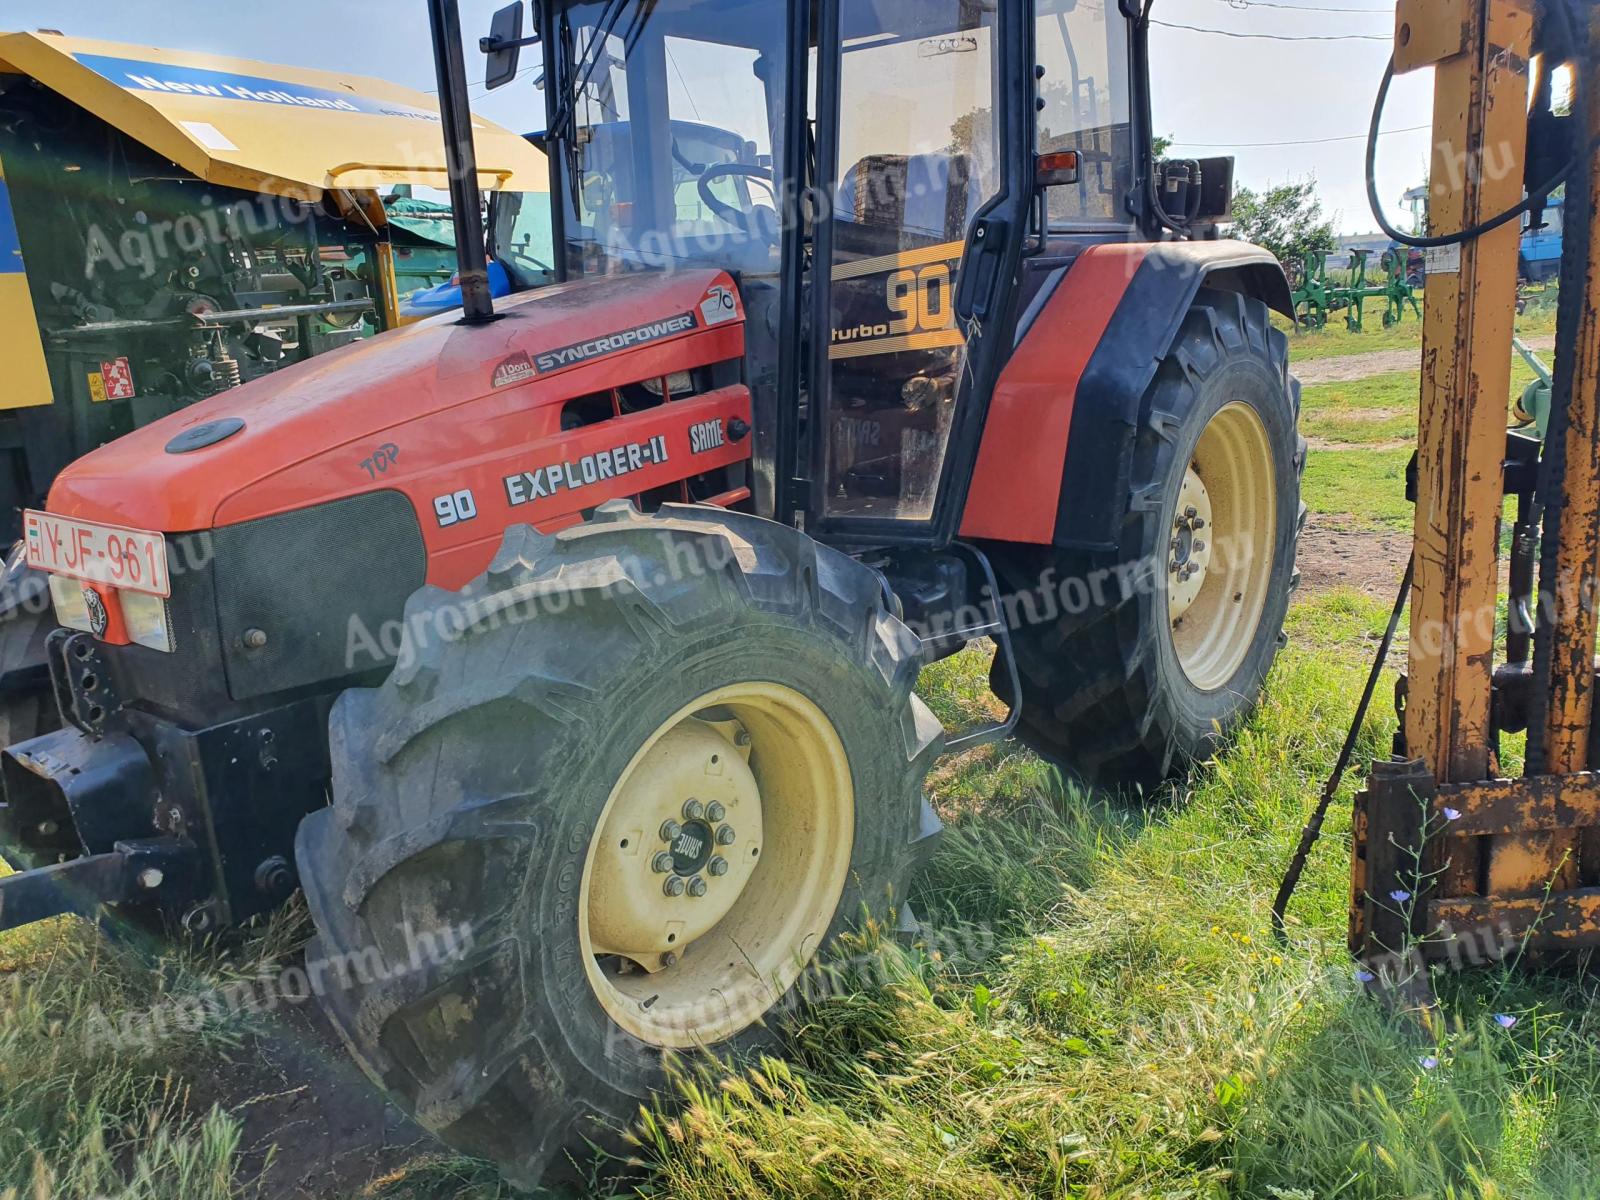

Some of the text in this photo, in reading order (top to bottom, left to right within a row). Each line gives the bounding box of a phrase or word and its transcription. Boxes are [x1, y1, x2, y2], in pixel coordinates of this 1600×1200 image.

[124, 72, 360, 112] New Holland
[831, 263, 951, 341] turbo 90
[537, 315, 694, 371] SYNCROPOWER
[690, 419, 724, 454] SAME
[359, 443, 399, 479] TOP
[505, 435, 669, 506] EXPLORER-II
[433, 489, 477, 527] 90
[30, 541, 41, 561] H
[45, 521, 158, 587] YJF-961
